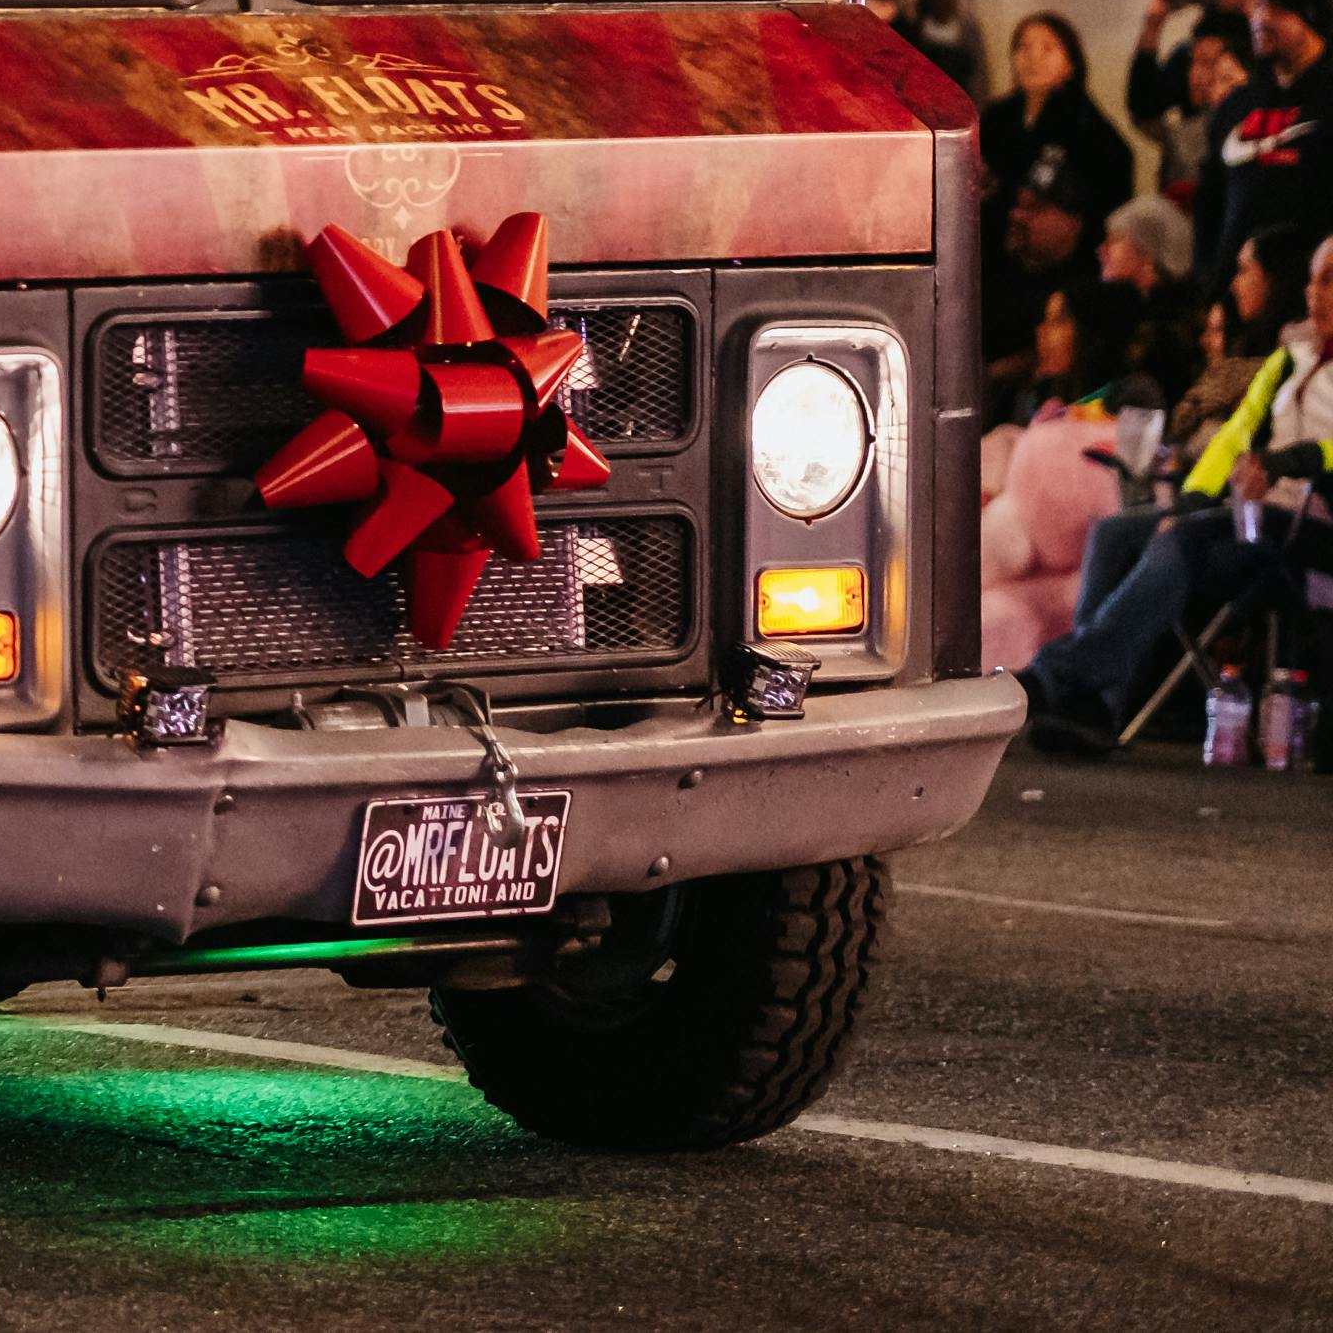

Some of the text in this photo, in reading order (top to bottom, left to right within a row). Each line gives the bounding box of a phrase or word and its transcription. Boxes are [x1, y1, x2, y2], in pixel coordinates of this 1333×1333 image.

[183, 75, 526, 129] MR. FLOATS
[284, 123, 494, 139] MEAT PACKING
[422, 803, 468, 821] MAINE
[374, 881, 536, 911] VACATIONLAND
